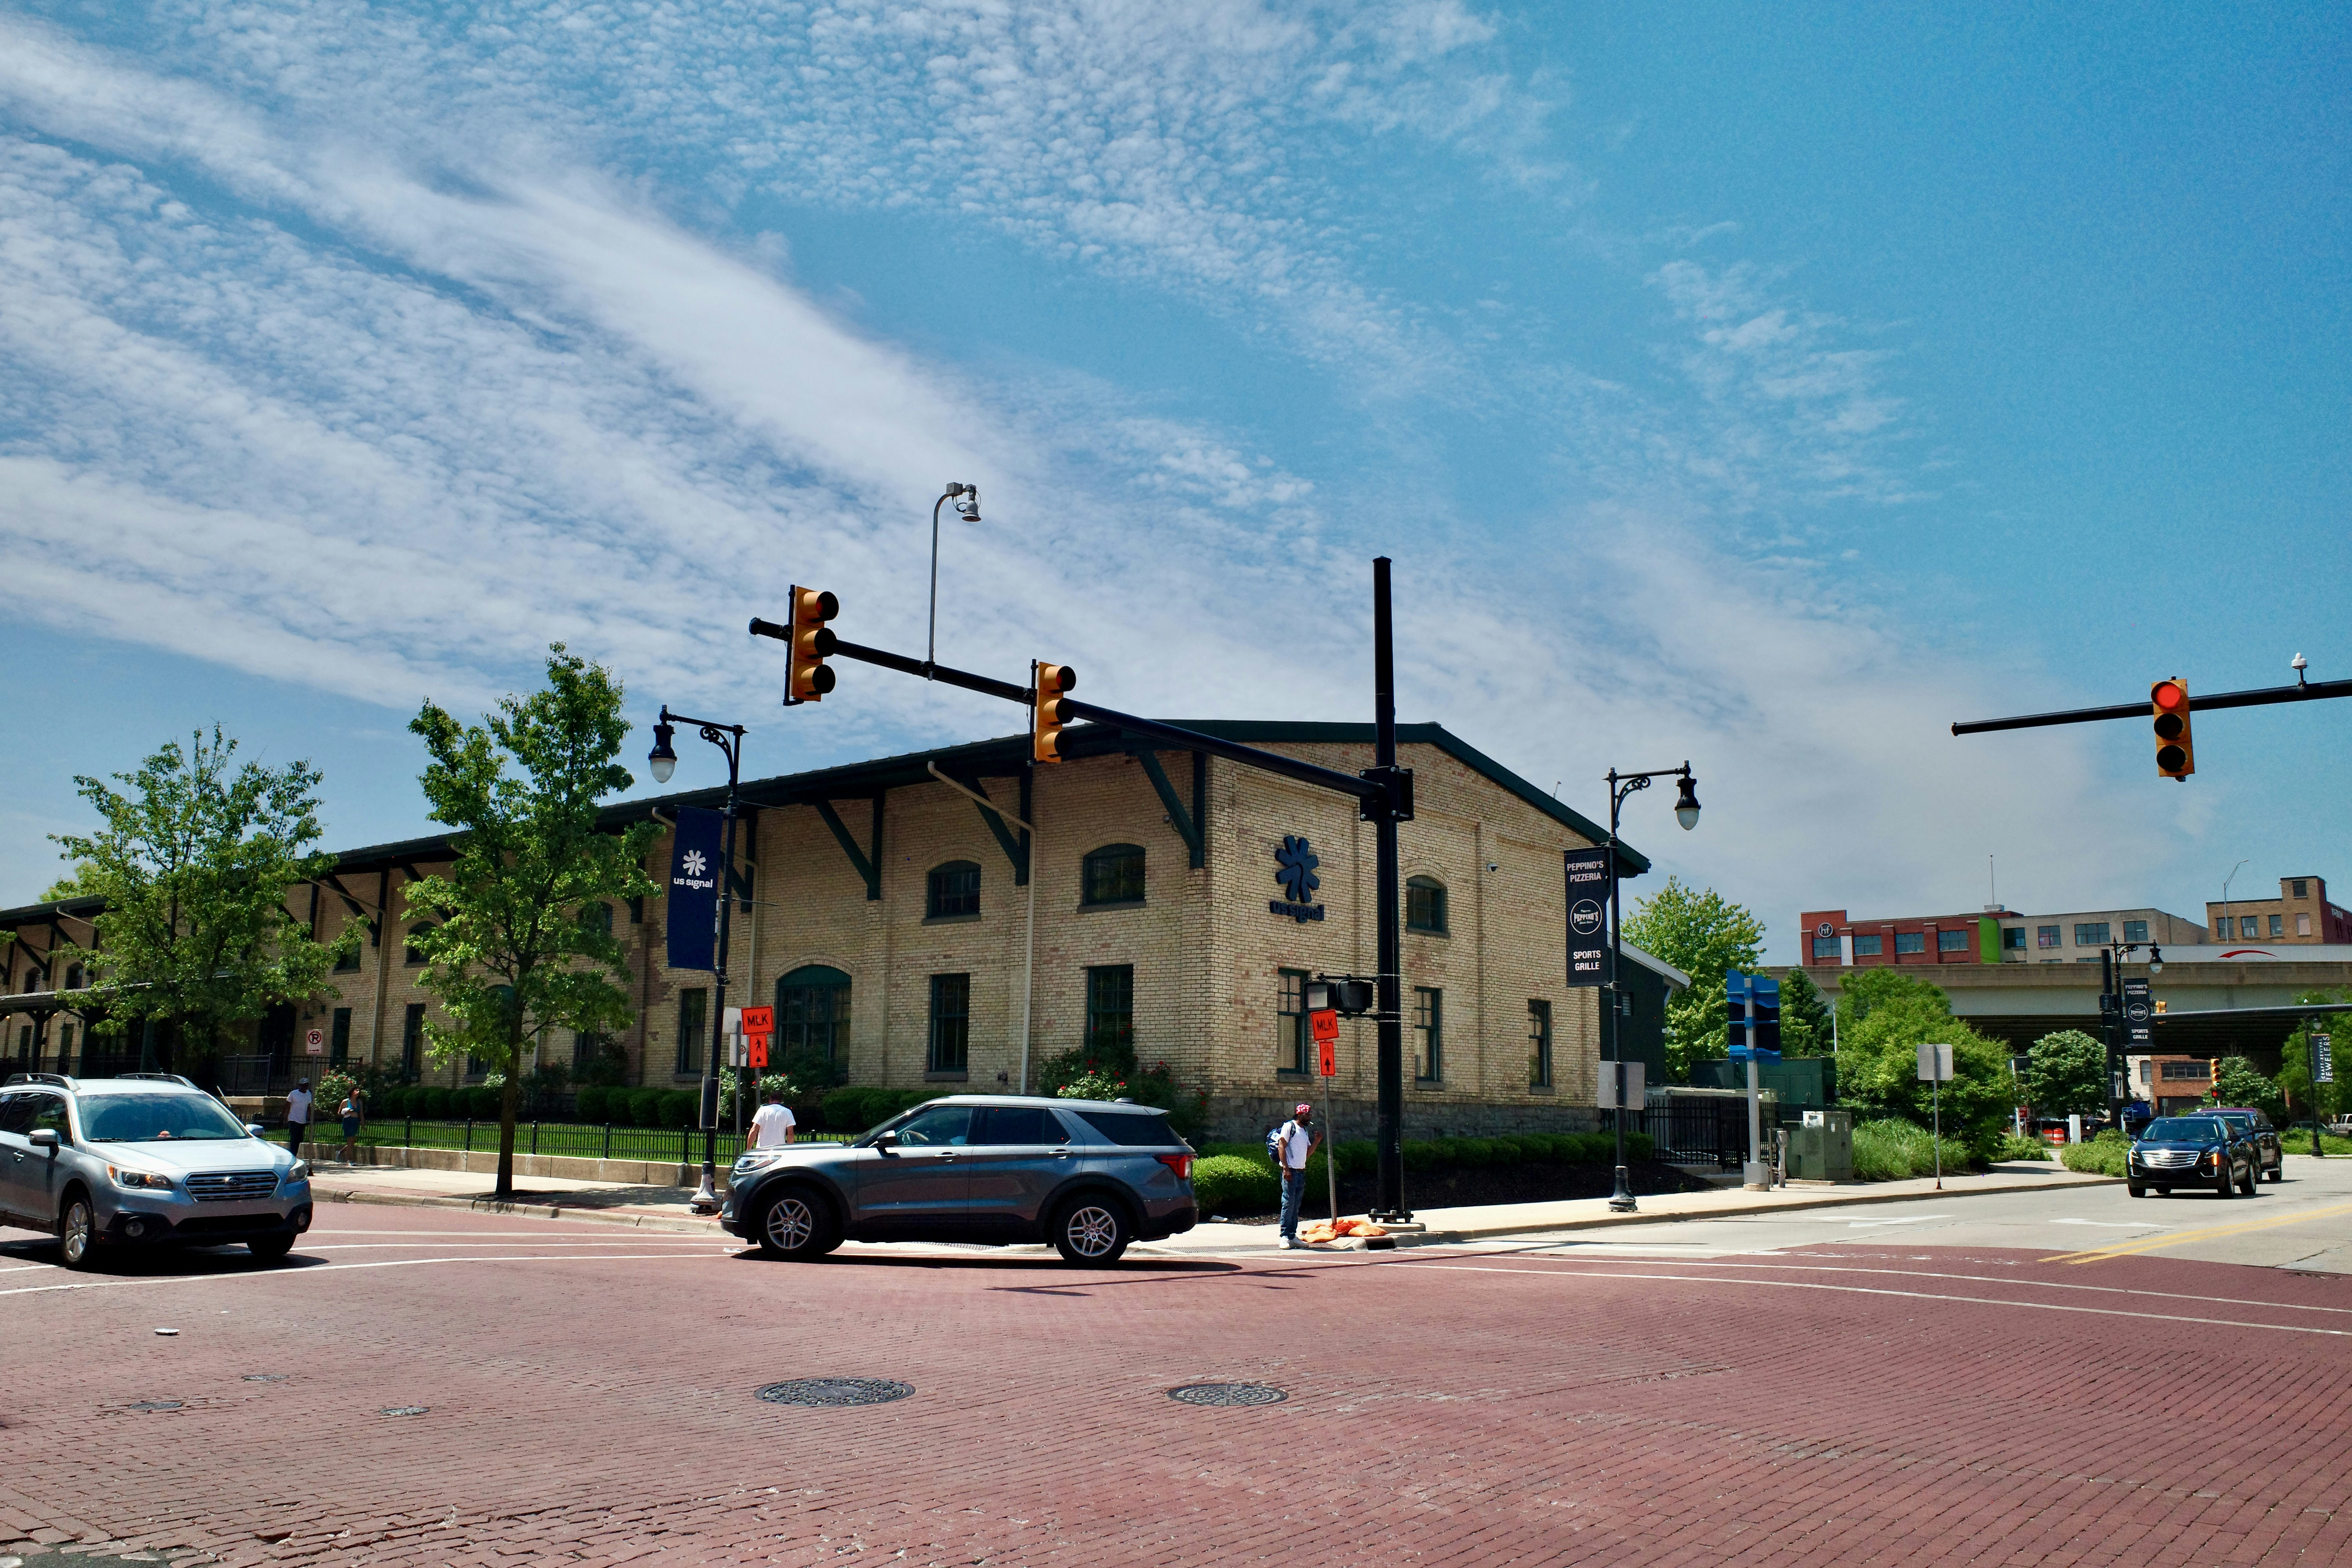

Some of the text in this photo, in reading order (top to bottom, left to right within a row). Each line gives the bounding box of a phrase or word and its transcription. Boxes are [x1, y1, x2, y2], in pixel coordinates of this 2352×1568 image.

[1567, 860, 1604, 871] PEPPINO'S
[1570, 872, 1602, 882] PIZZERIA
[686, 879, 713, 889] signal
[1270, 901, 1324, 924] us signal
[1573, 911, 1598, 924] PEPPINO'S
[1821, 926, 1830, 935] hf
[1573, 950, 1601, 960] SPORTS
[1575, 962, 1600, 971] GRILLE
[747, 1014, 768, 1027] MLK
[1316, 1018, 1334, 1032] MLK
[2323, 1036, 2333, 1081] JEWELERS
